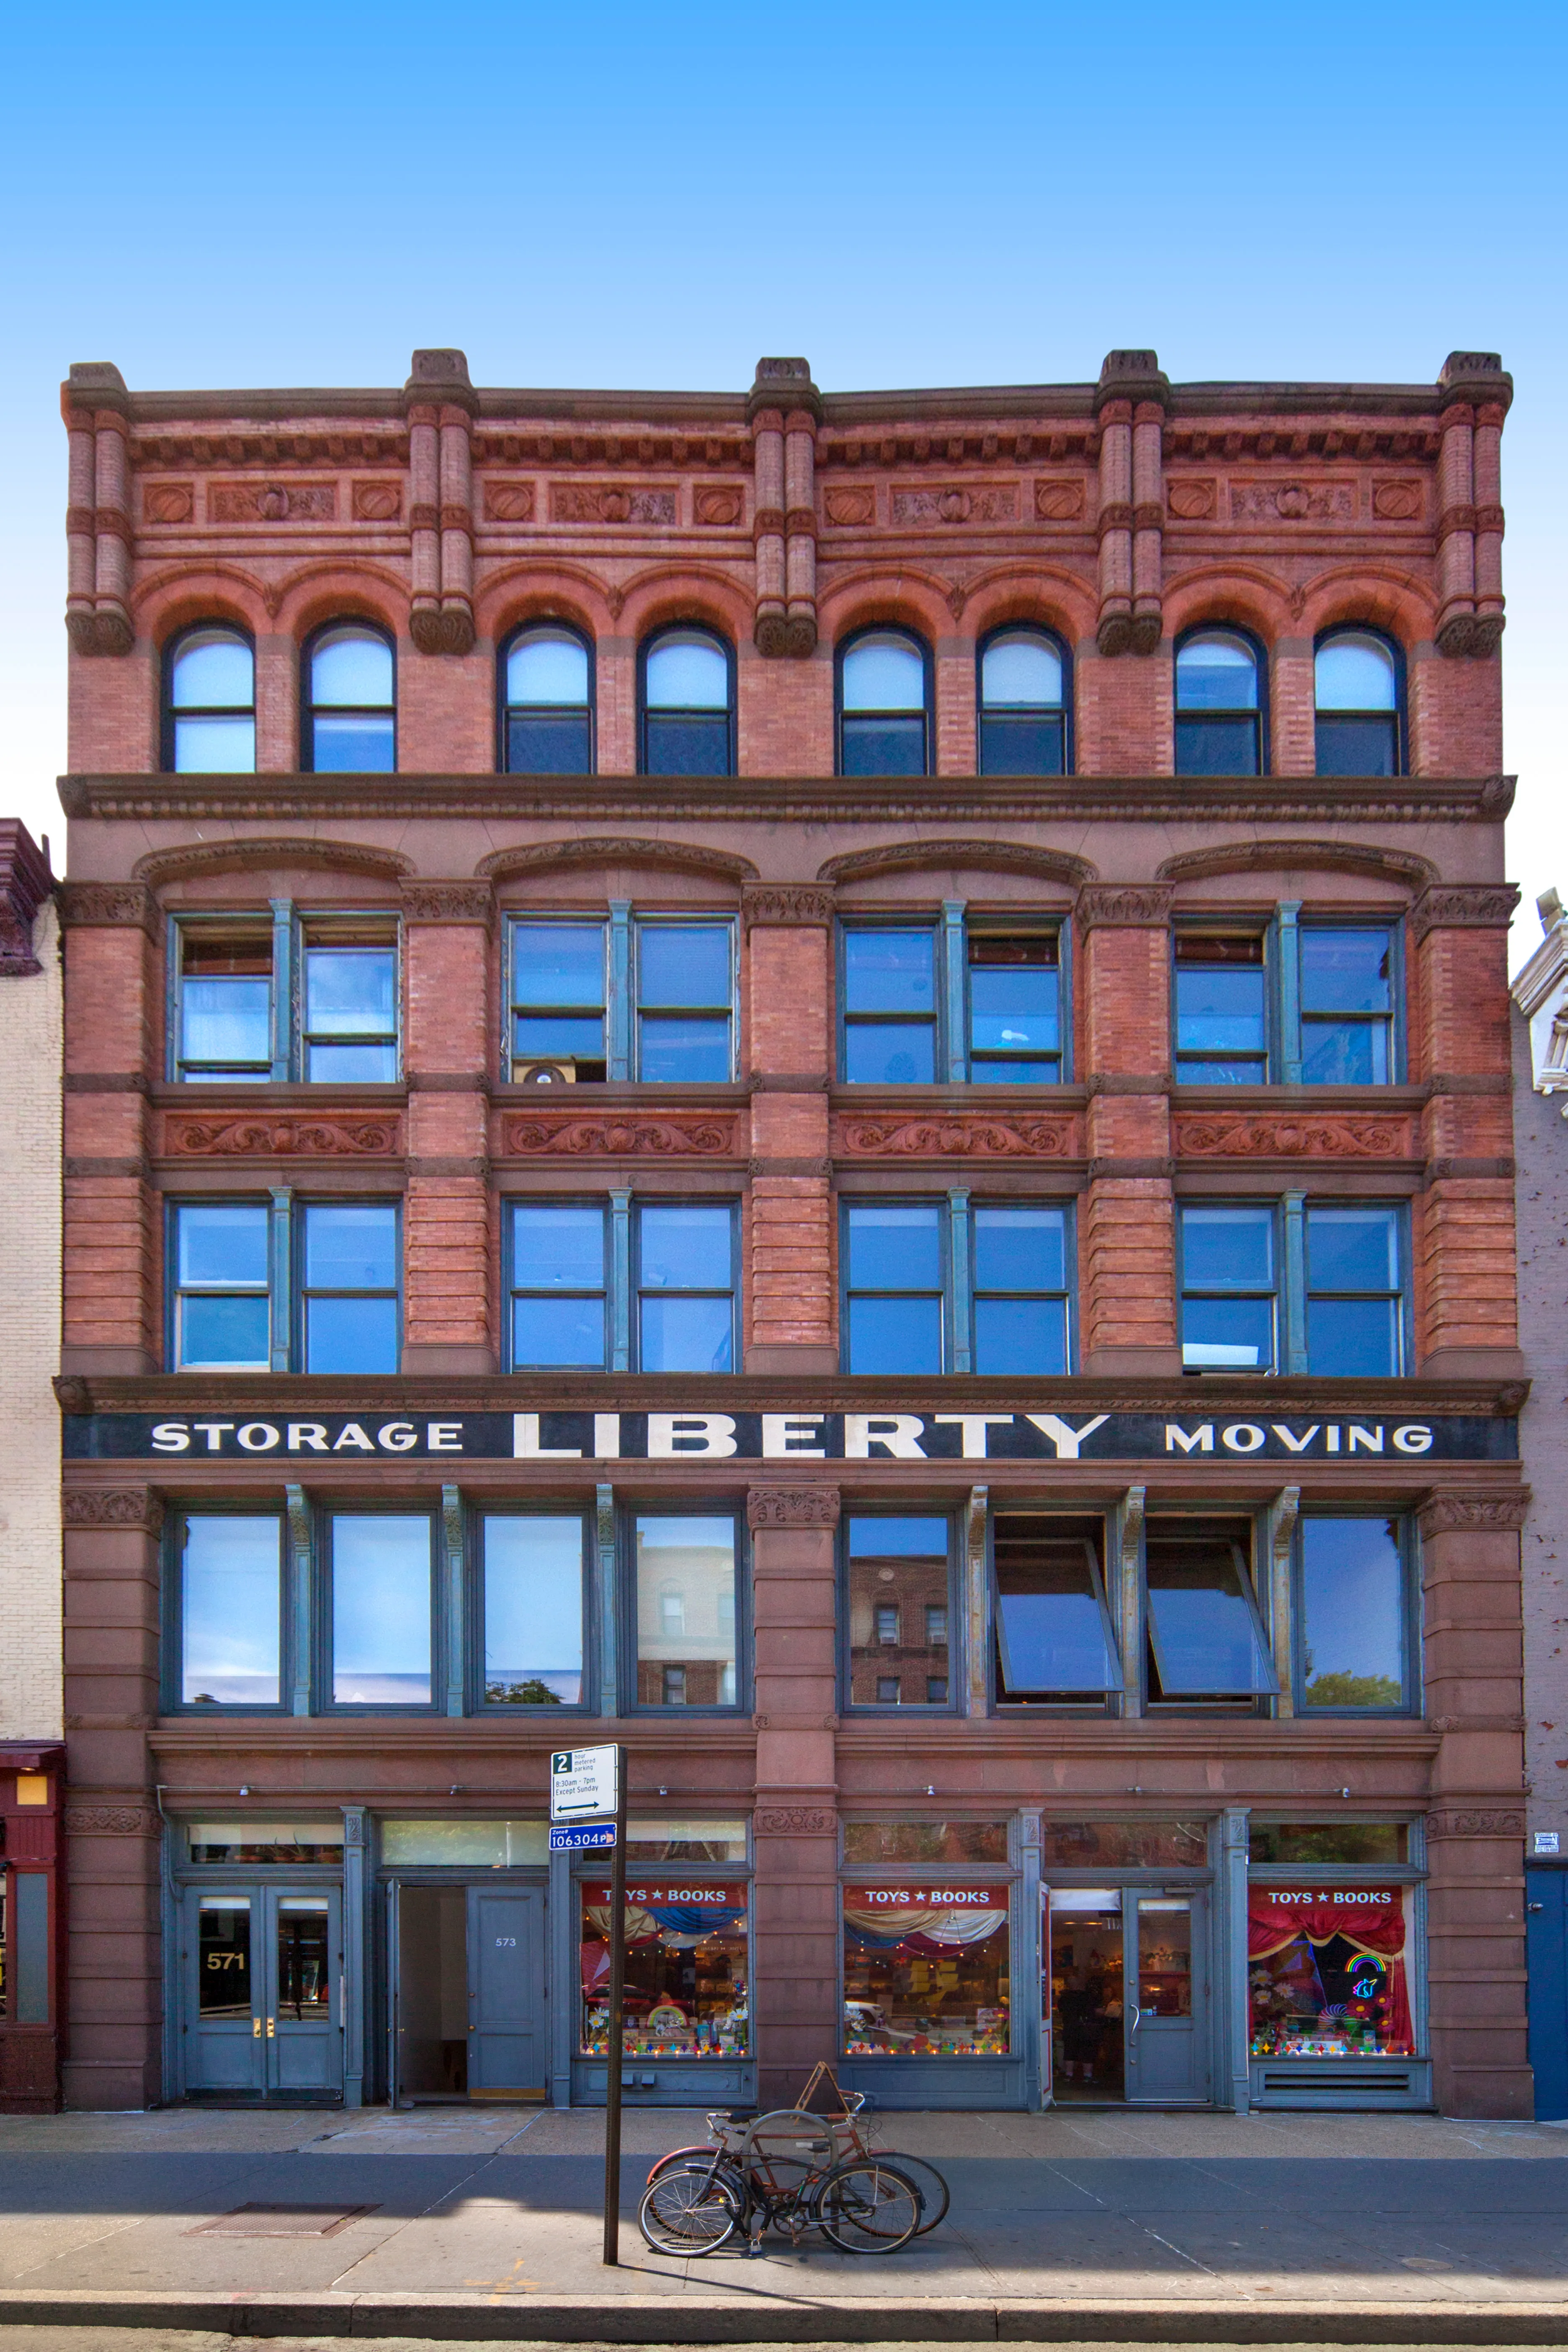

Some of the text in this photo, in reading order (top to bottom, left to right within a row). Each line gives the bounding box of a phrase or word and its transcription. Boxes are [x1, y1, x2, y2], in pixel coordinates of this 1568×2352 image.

[152, 1413, 1433, 1458] STORAGE LIBERTY MOVING
[557, 1754, 567, 1772] 2
[552, 1834, 598, 1847] 106304
[602, 1890, 727, 1901] TYS BOOKS
[865, 1891, 990, 1903] TOYS BOOKS
[1268, 1893, 1392, 1903] TOYS BOOKS
[495, 1937, 516, 1947] 573
[207, 1952, 245, 1970] 571
